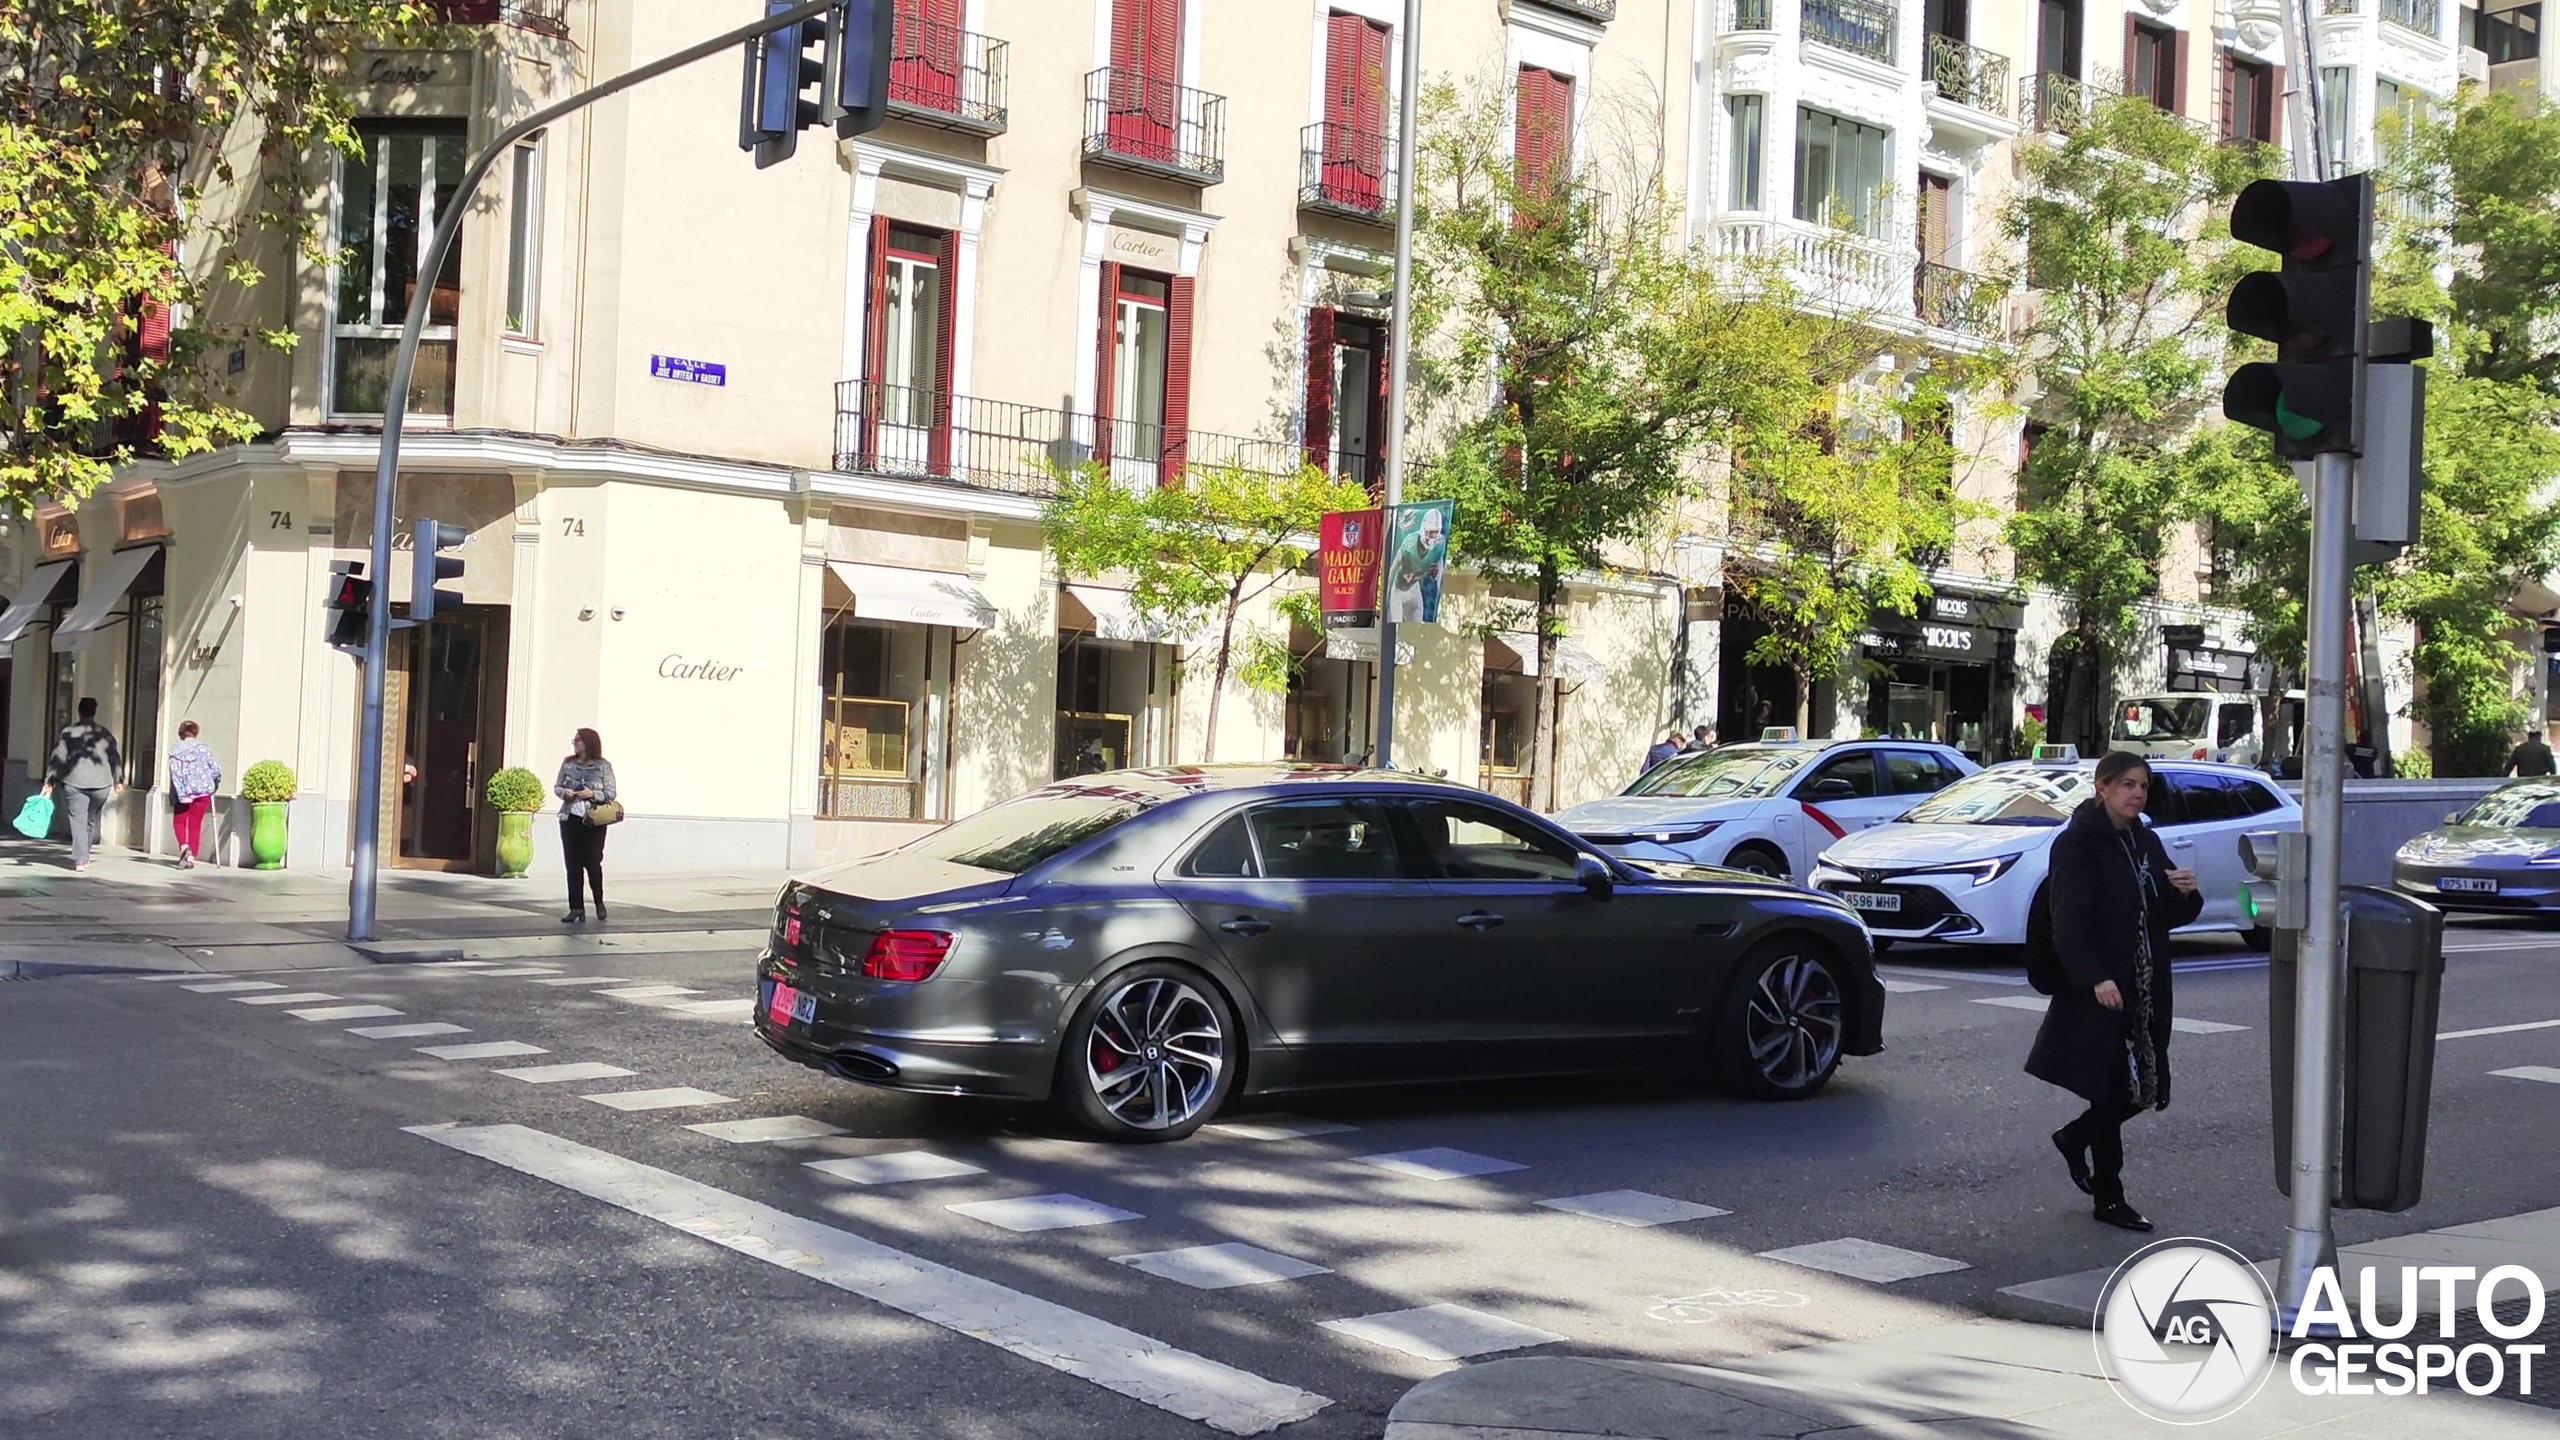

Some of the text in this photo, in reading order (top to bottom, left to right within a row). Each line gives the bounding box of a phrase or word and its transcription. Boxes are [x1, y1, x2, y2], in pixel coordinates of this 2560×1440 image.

[368, 58, 439, 84] Cartier
[1113, 232, 1164, 257] Cartier
[674, 359, 706, 369] CALLE
[655, 366, 671, 378] JOSÉ
[672, 369, 694, 381] ORTEGA
[695, 373, 700, 381] Y
[270, 511, 292, 530] 74
[562, 517, 585, 537] 74
[1323, 549, 1375, 567] MADRID
[1327, 567, 1364, 584] GAME
[910, 605, 943, 619] Cartier
[658, 653, 744, 682] Cartier
[2443, 879, 2468, 891] 9751
[1846, 894, 1899, 909] 8596 MHR
